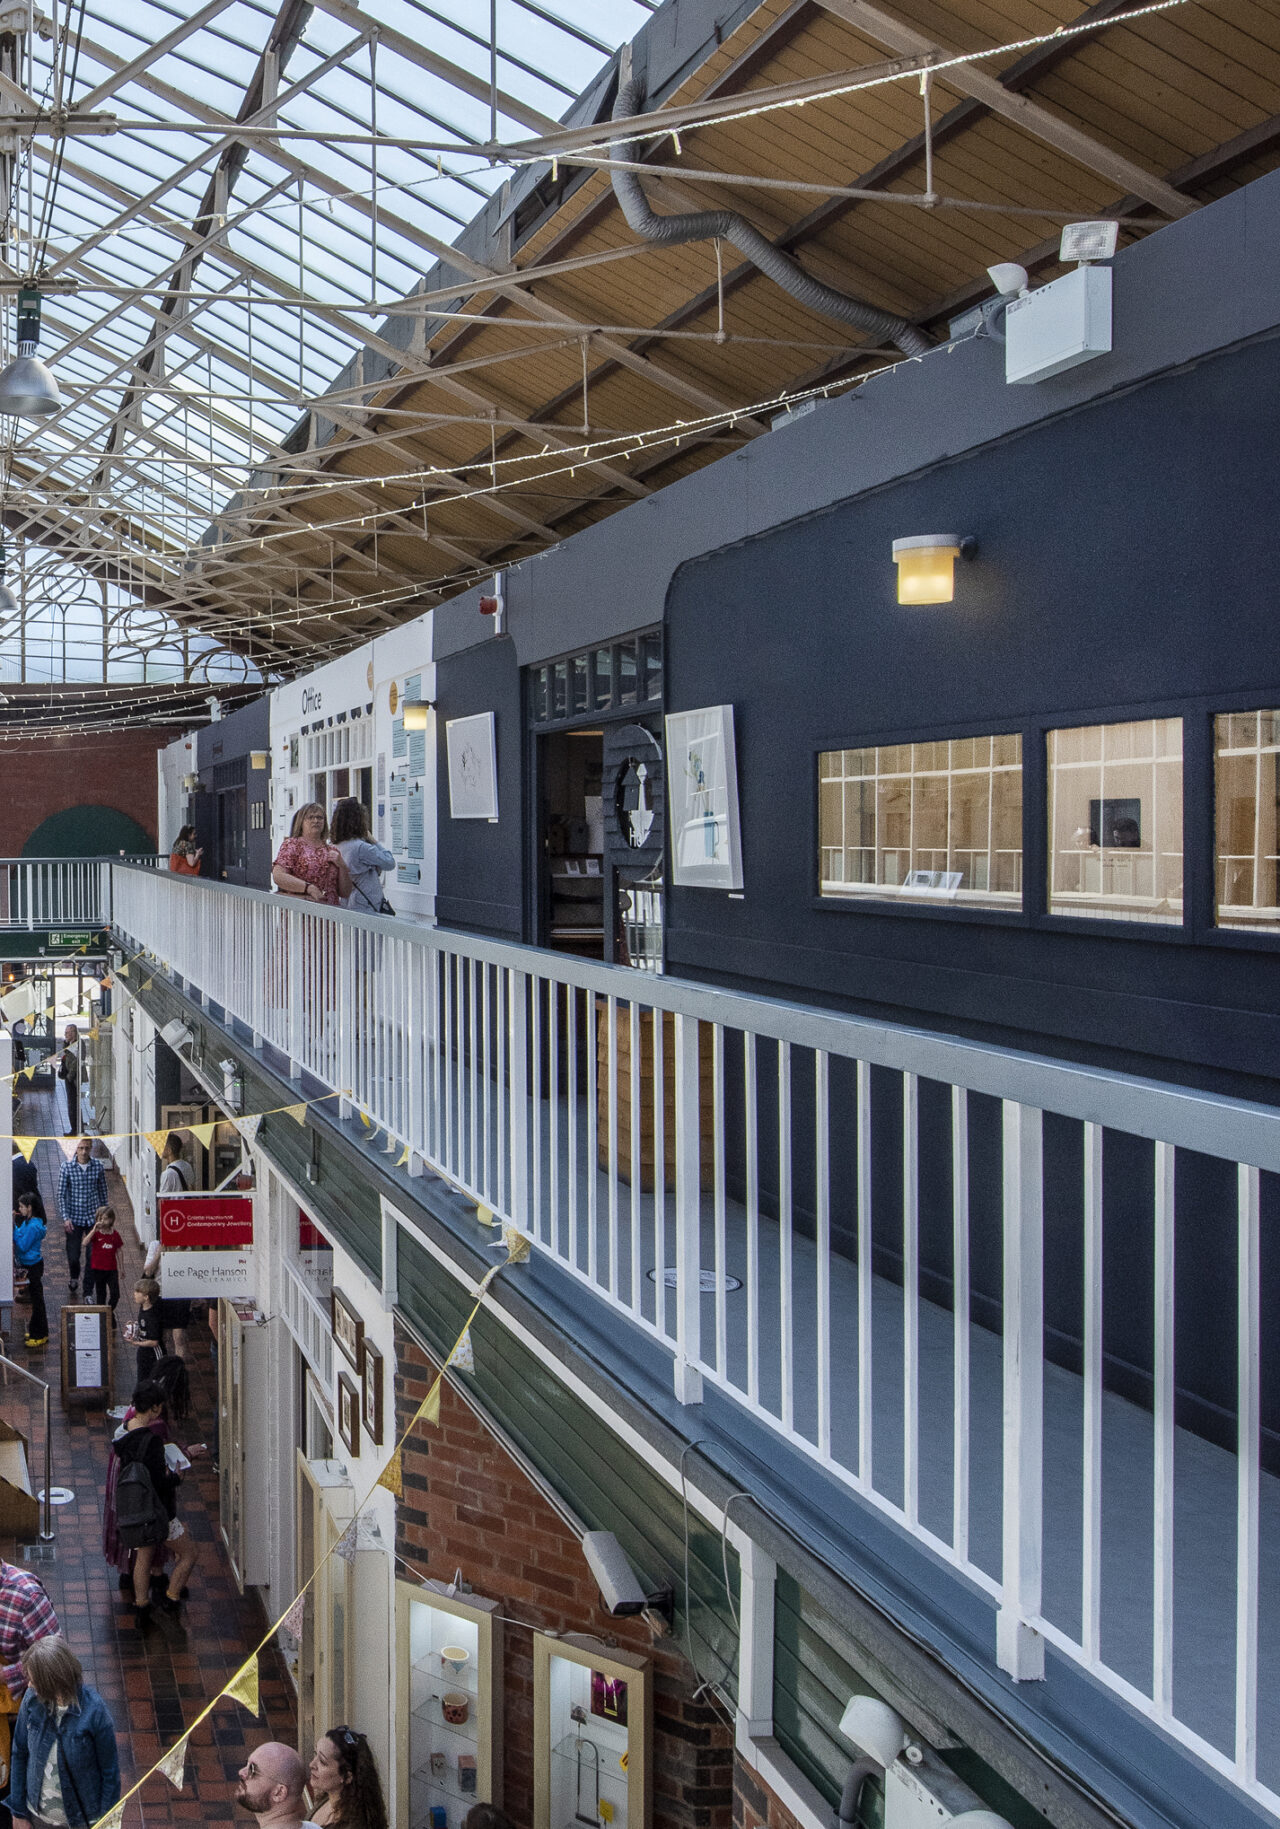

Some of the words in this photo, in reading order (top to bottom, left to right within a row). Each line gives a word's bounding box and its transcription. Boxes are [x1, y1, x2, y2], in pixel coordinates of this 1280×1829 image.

[301, 686, 322, 715] Office
[170, 1216, 179, 1226] H
[168, 1267, 185, 1277] Lee
[187, 1266, 210, 1280] Page
[211, 1266, 247, 1277] Hanson
